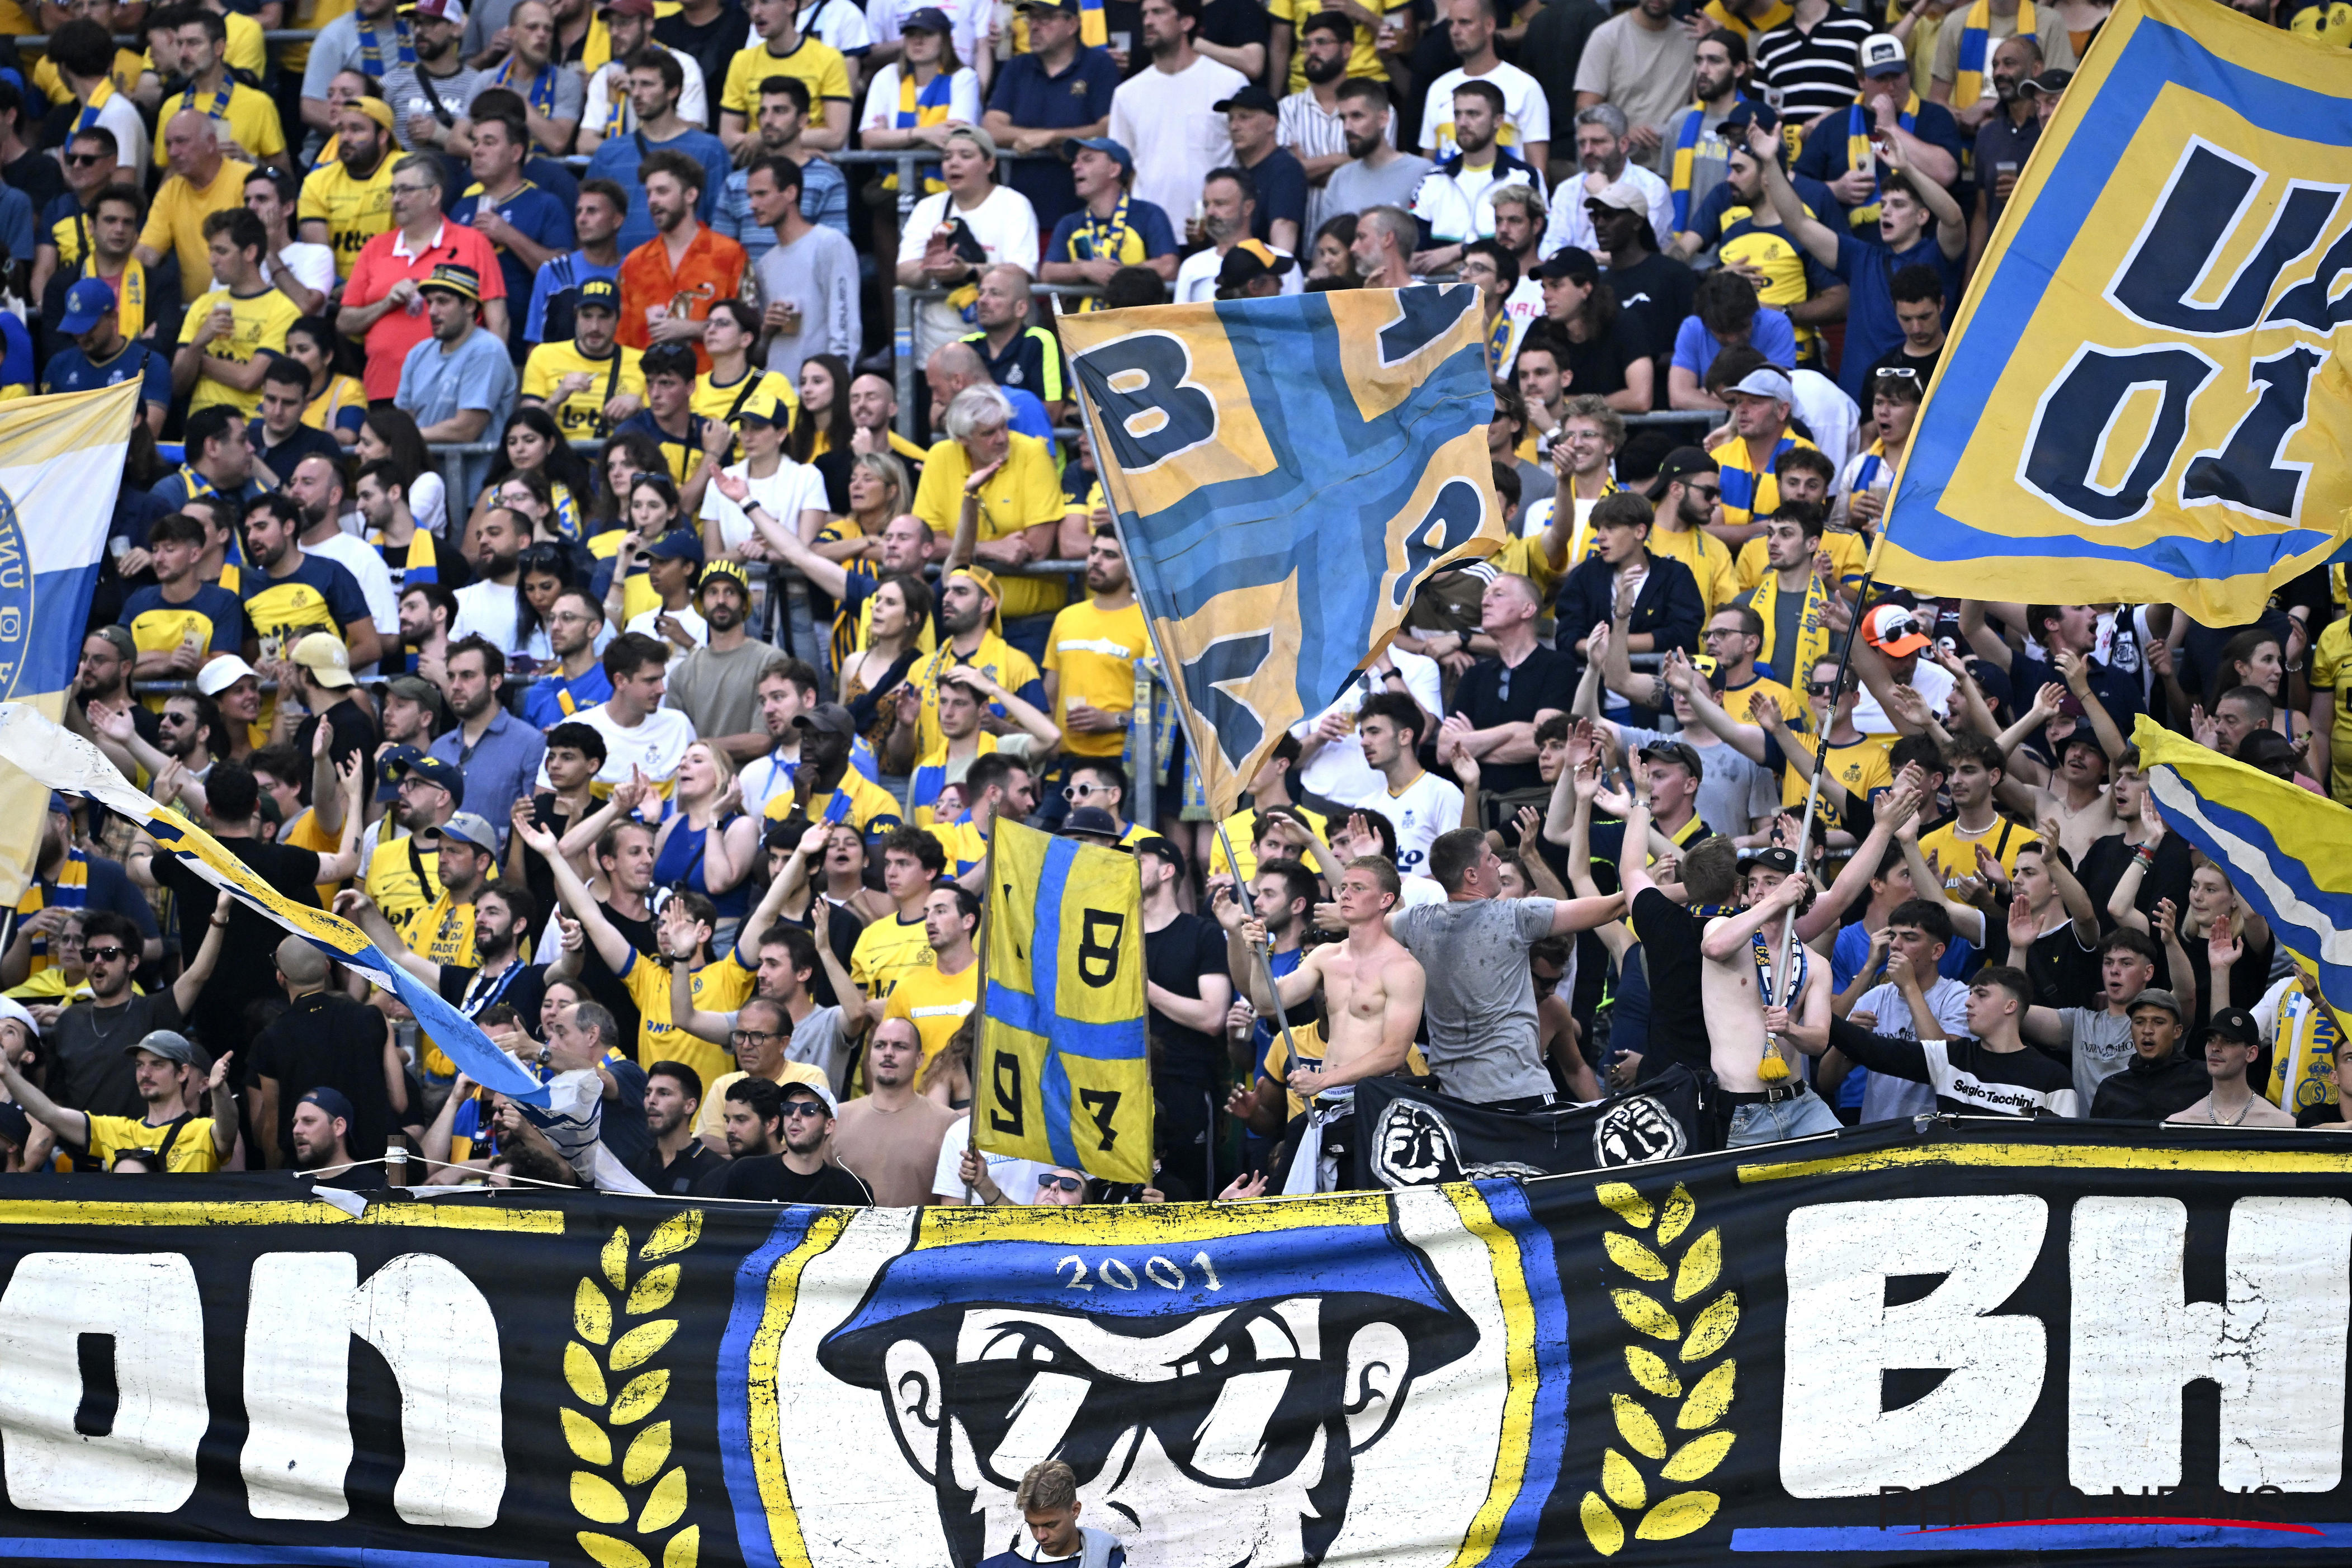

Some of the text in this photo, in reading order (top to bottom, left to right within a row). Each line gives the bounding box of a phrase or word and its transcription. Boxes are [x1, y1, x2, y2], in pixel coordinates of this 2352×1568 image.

[1505, 302, 1539, 318] IRL
[1069, 329, 1218, 475] B
[1953, 1079, 2035, 1108] Sergio Tacchini
[1055, 1250, 1224, 1292] 2001
[1779, 1193, 2352, 1500] BH
